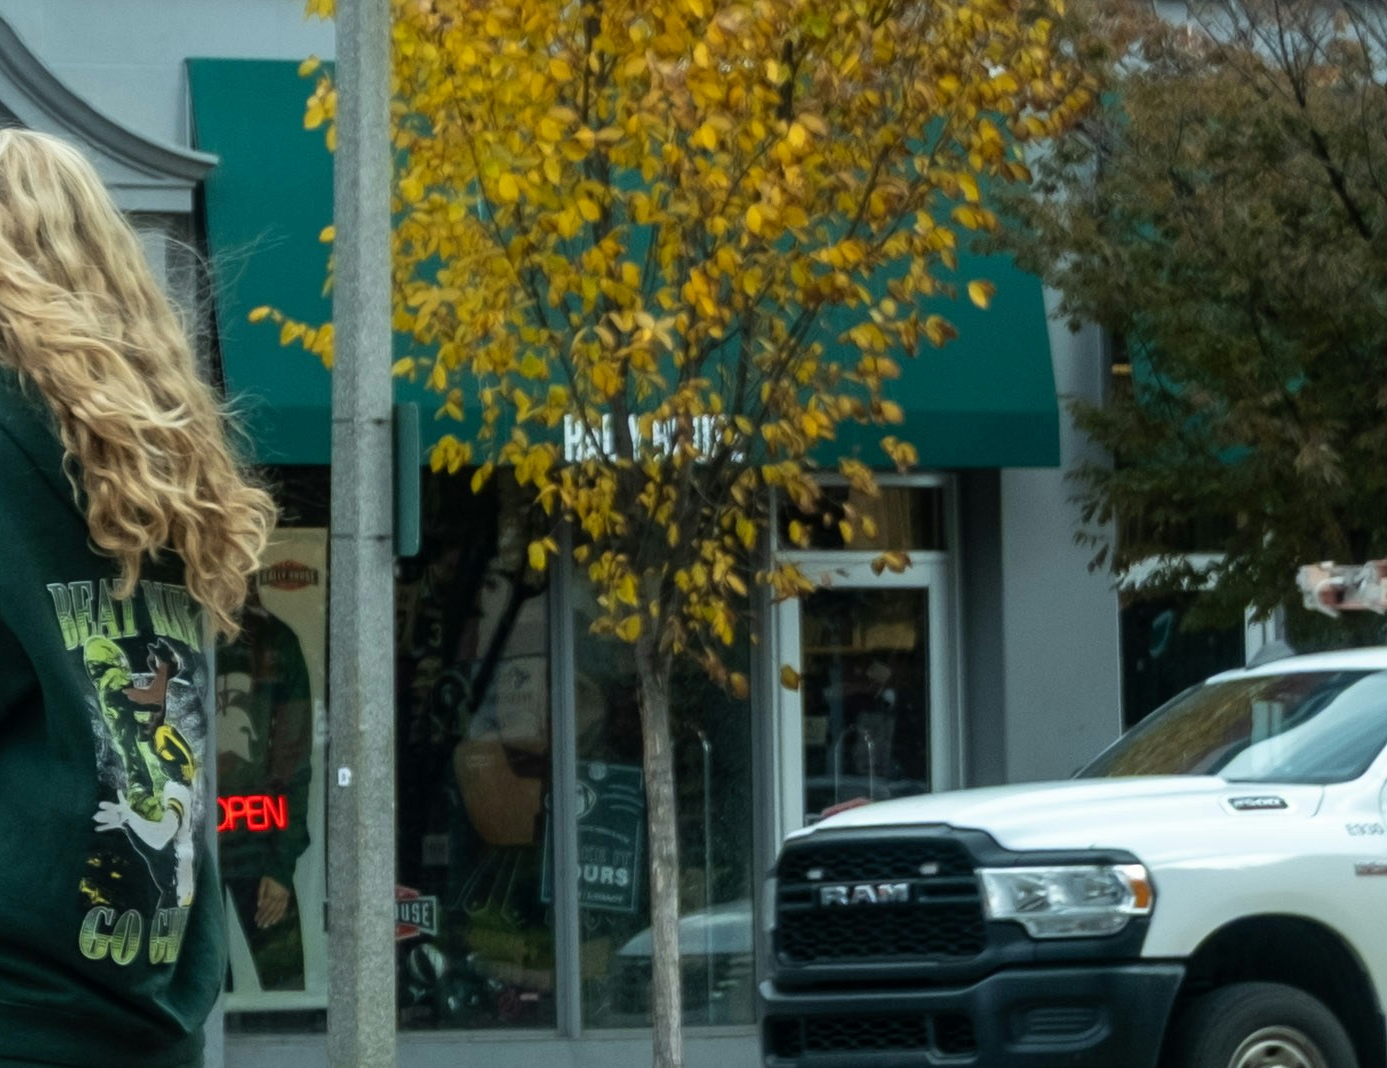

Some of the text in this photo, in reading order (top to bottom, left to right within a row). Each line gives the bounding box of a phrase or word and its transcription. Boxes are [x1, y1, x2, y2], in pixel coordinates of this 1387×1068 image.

[564, 414, 643, 463] RALY
[46, 578, 139, 650] BEAT
[576, 864, 629, 887] URS
[820, 883, 909, 904] RAM
[78, 906, 142, 966] GO
